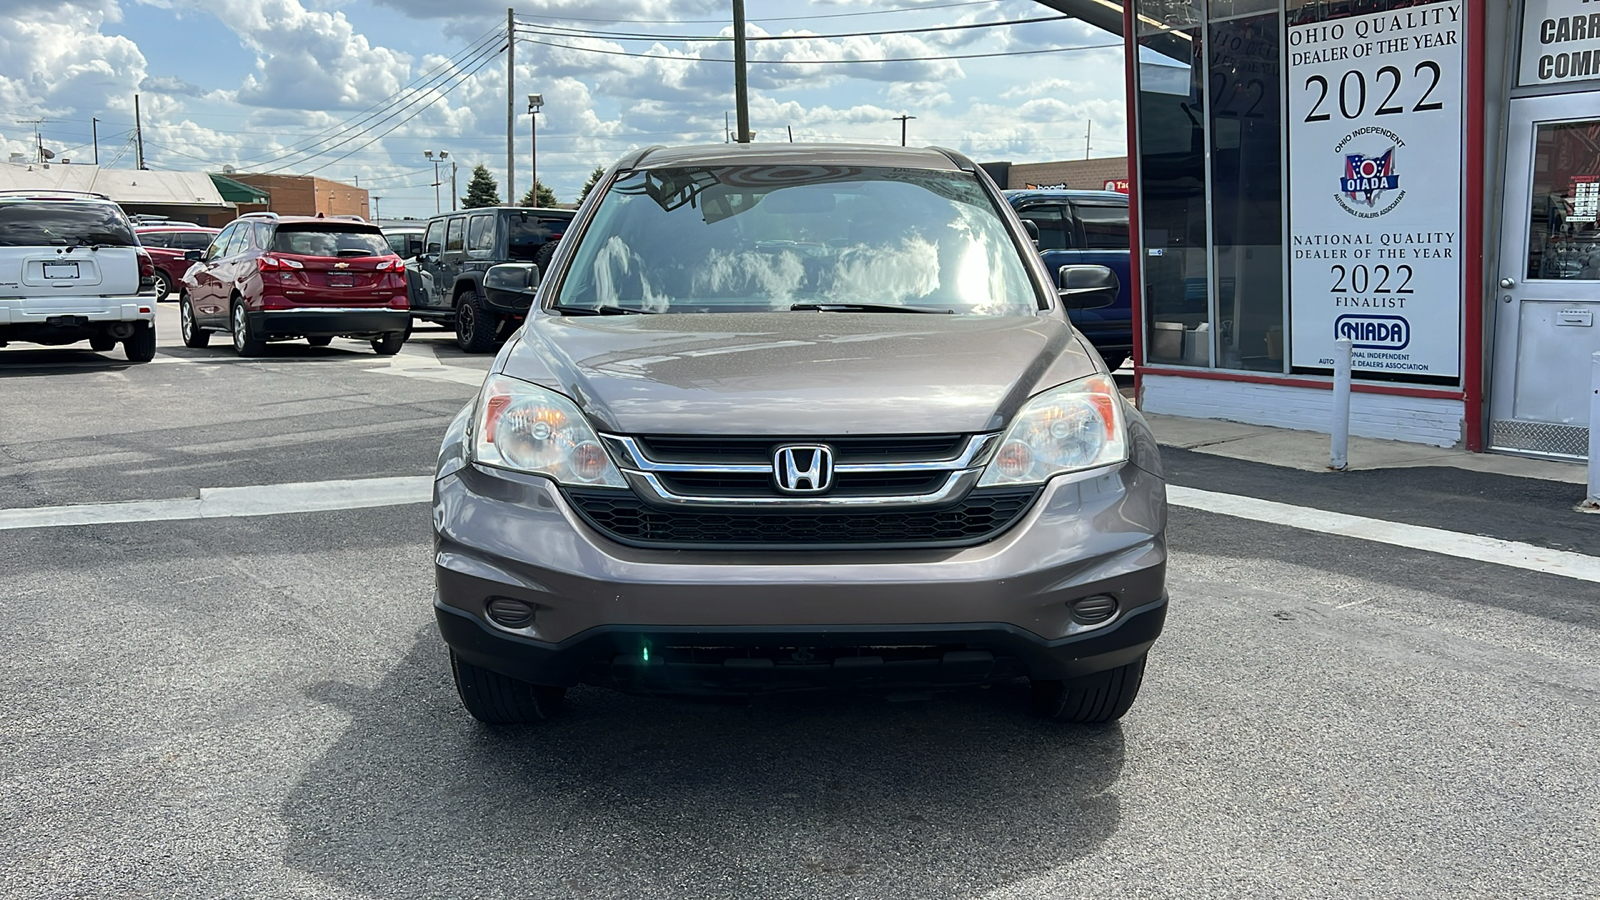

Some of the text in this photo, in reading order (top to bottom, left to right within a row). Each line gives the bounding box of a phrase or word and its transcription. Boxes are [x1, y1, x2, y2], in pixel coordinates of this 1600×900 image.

[1290, 24, 1344, 46] OHIO
[1355, 5, 1461, 39] QUALITY
[1292, 46, 1349, 66] DEALER
[1353, 43, 1373, 58] OF
[1377, 37, 1409, 54] THE
[1412, 30, 1457, 49] YEAR
[1304, 60, 1443, 123] 2022
[1334, 126, 1406, 153] OHIO INDEPENDENT
[1347, 177, 1389, 191] OIADA
[1333, 193, 1358, 217] AUTOMOBILE
[1380, 189, 1406, 216] ASSOCIATION
[1293, 232, 1455, 246] NATIONAL QUALITY
[1295, 248, 1453, 259] DEALER OF THE YEAR
[1330, 264, 1414, 294] 2022
[1335, 296, 1407, 309] FINALIST
[1340, 322, 1403, 343] NIADA
[1357, 360, 1384, 369] DEALERS
[1385, 361, 1429, 371] ASSOCIATION
[1367, 353, 1410, 361] INDEPENDENT
